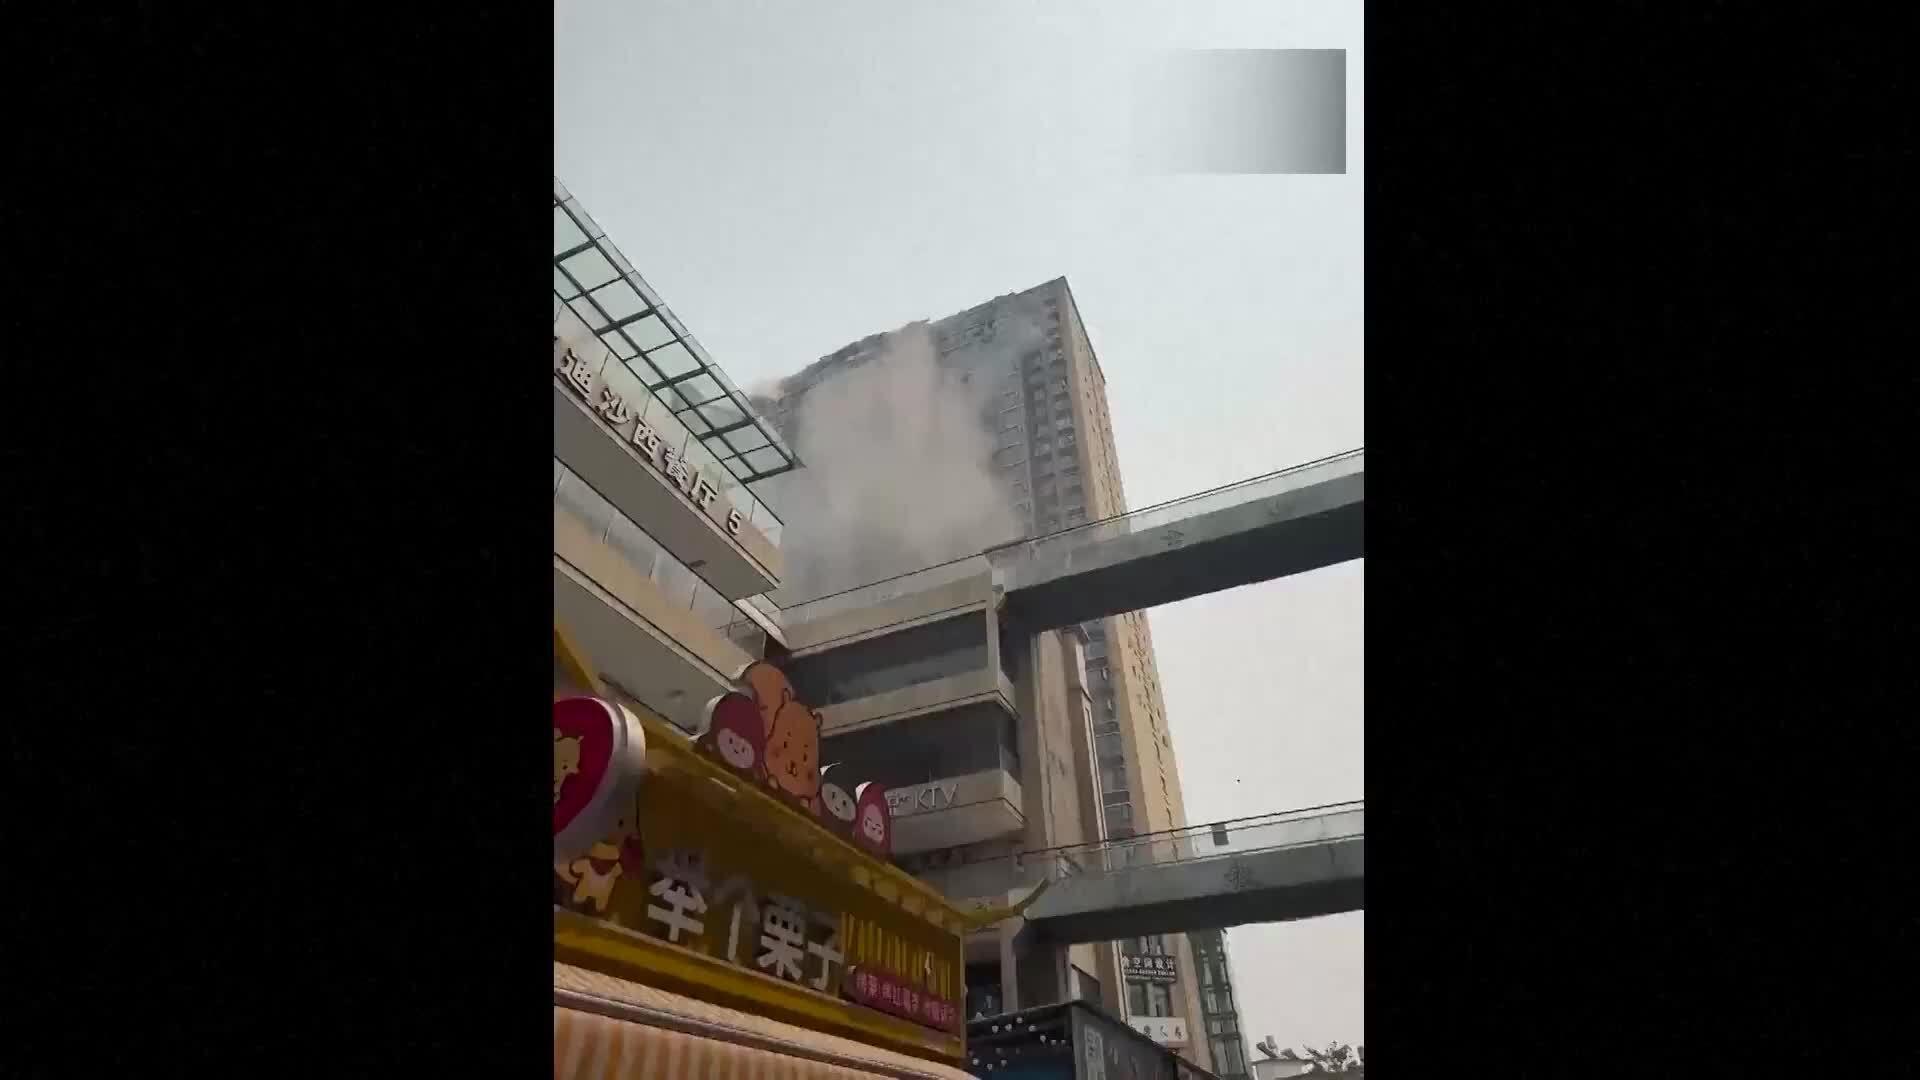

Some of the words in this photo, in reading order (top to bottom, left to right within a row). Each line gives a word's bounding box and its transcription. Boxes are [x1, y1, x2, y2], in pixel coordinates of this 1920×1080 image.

[914, 783, 958, 809] KTV
[647, 852, 844, 991] 举个栗子
